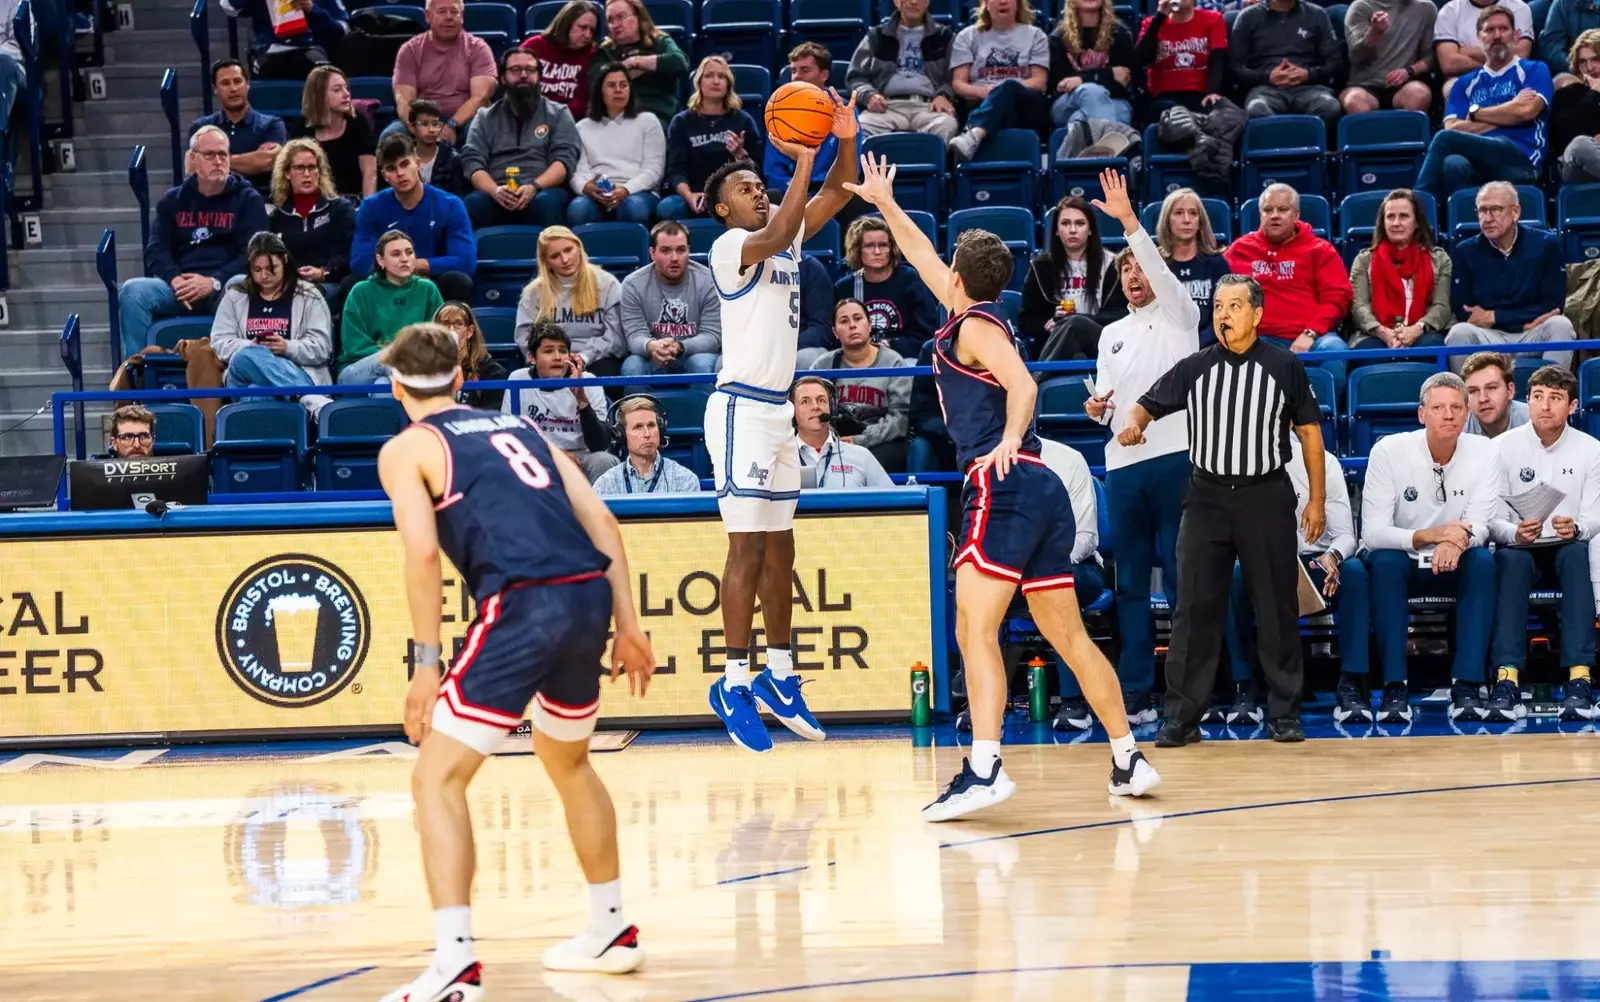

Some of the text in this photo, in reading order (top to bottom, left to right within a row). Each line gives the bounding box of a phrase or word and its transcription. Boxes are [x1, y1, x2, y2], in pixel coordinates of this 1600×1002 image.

[92, 79, 102, 95] G
[62, 148, 71, 165] F
[27, 221, 38, 238] E
[769, 269, 791, 286] AIR
[788, 291, 800, 329] 5
[866, 302, 897, 319] LMONT
[651, 321, 697, 337] BELMONT
[835, 383, 886, 409] LMONT
[489, 431, 552, 490] 8
[639, 568, 852, 617] LOAL
[0, 590, 89, 636] AL
[231, 569, 357, 694] BRISTOL BREWING COMPANY
[912, 680, 925, 694] G
